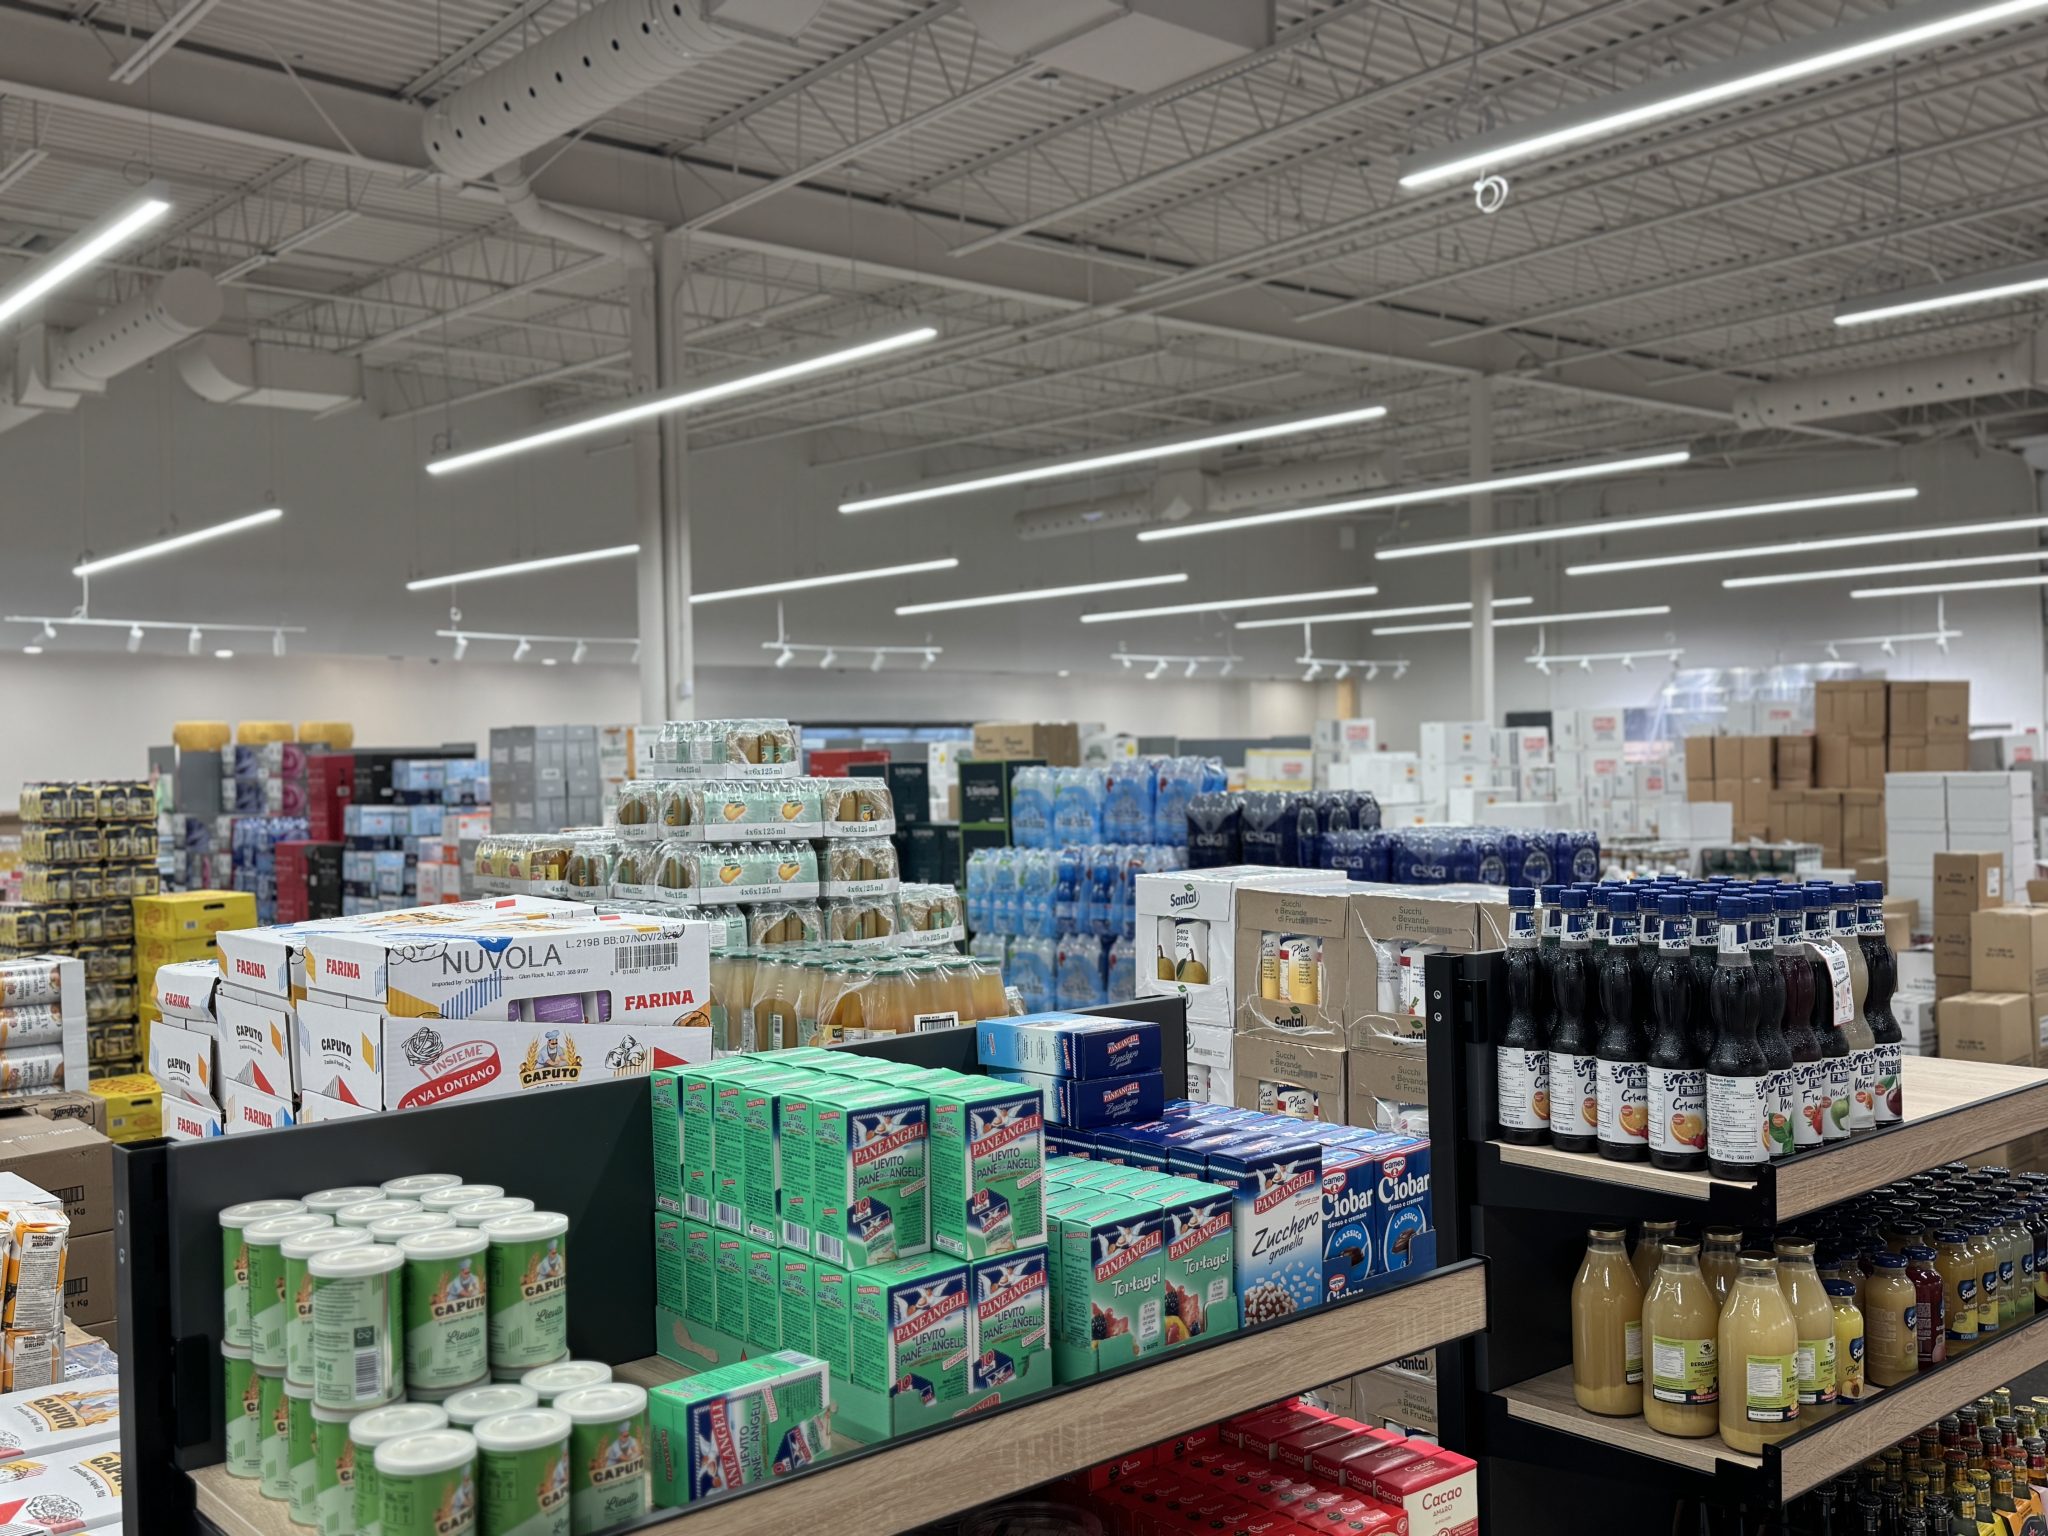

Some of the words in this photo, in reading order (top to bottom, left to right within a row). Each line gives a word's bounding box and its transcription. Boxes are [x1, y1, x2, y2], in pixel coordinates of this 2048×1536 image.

[1410, 862, 1446, 879] eska
[1170, 890, 1197, 907] Santal
[1280, 900, 1302, 908] Succhi
[1280, 908, 1307, 916] Bevande
[1398, 914, 1429, 925] Bevande
[1400, 906, 1422, 916] Succhi
[1404, 924, 1427, 933] Frutta
[1292, 944, 1310, 956] Plus
[442, 944, 563, 975] NUVOLA
[236, 958, 266, 979] FARINA
[326, 958, 360, 979] FARINA
[165, 992, 191, 1010] FARINA
[625, 990, 694, 1011] FARINA
[1275, 1016, 1304, 1028] Santal
[236, 1025, 263, 1043] CAPUTO
[321, 1038, 352, 1056] CAPUTO
[1108, 1034, 1139, 1054] PANEANGELI
[433, 1045, 484, 1074] INSIEME
[1275, 1050, 1296, 1060] Succhi
[167, 1058, 191, 1074] CAPUTO
[1275, 1059, 1301, 1070] Bevande
[1398, 1066, 1421, 1076] Succhi
[418, 1089, 435, 1102] VA
[436, 1065, 496, 1096] LONTANO
[523, 1068, 578, 1084] CAPUTO
[1104, 1082, 1139, 1103] PANEANGELI
[1404, 1084, 1425, 1094] Frutta
[1288, 1095, 1306, 1108] Plus
[244, 1106, 273, 1128] FARINA
[177, 1117, 203, 1138] FARINA
[973, 1116, 1040, 1156] PANEANGELI
[854, 1124, 924, 1163] PANEANGELI
[977, 1163, 998, 1179] PANE
[1384, 1159, 1405, 1170] cameo
[858, 1172, 880, 1187] PANE
[1324, 1174, 1345, 1186] cameo
[1256, 1172, 1313, 1213] PANEANGELI
[1378, 1173, 1429, 1204] Ciobar
[855, 1197, 870, 1214] 10
[974, 1189, 989, 1206] 10
[1322, 1188, 1373, 1220] Ciobar
[74, 1208, 86, 1216] Kg
[1388, 1203, 1402, 1212] denso
[1328, 1220, 1343, 1229] denso
[1394, 1212, 1418, 1229] CLASSICO
[1170, 1213, 1229, 1258] PANEANGELI
[1252, 1212, 1319, 1256] Zucchero
[1335, 1229, 1362, 1247] CLASSICO
[1097, 1232, 1159, 1281] PANEANGELI
[1269, 1234, 1303, 1264] granella
[1184, 1247, 1229, 1274] Tortagel
[1111, 1267, 1161, 1298] Tortagel
[78, 1299, 88, 1307] Kg
[979, 1272, 1043, 1317] PANEANGELI
[896, 1293, 966, 1340] PANEANGELI
[984, 1325, 1004, 1341] PANE
[901, 1346, 921, 1365] PANE
[980, 1351, 994, 1367] 10
[896, 1375, 912, 1392] 10
[1404, 1391, 1427, 1404] Succhi
[34, 1398, 78, 1428] CAPUTO
[1410, 1410, 1432, 1422] Frutta
[1221, 1430, 1239, 1441] acao
[1244, 1434, 1269, 1451] Cacao
[714, 1403, 742, 1488] ANEANGELI
[1278, 1447, 1304, 1464] Cacao
[1312, 1460, 1339, 1477] Cacao
[1405, 1460, 1435, 1473] Cacao
[1346, 1470, 1372, 1488] Cacao
[1376, 1485, 1402, 1504] Cacao
[1422, 1487, 1462, 1510] Cacao
[1432, 1504, 1453, 1517] AMARO
